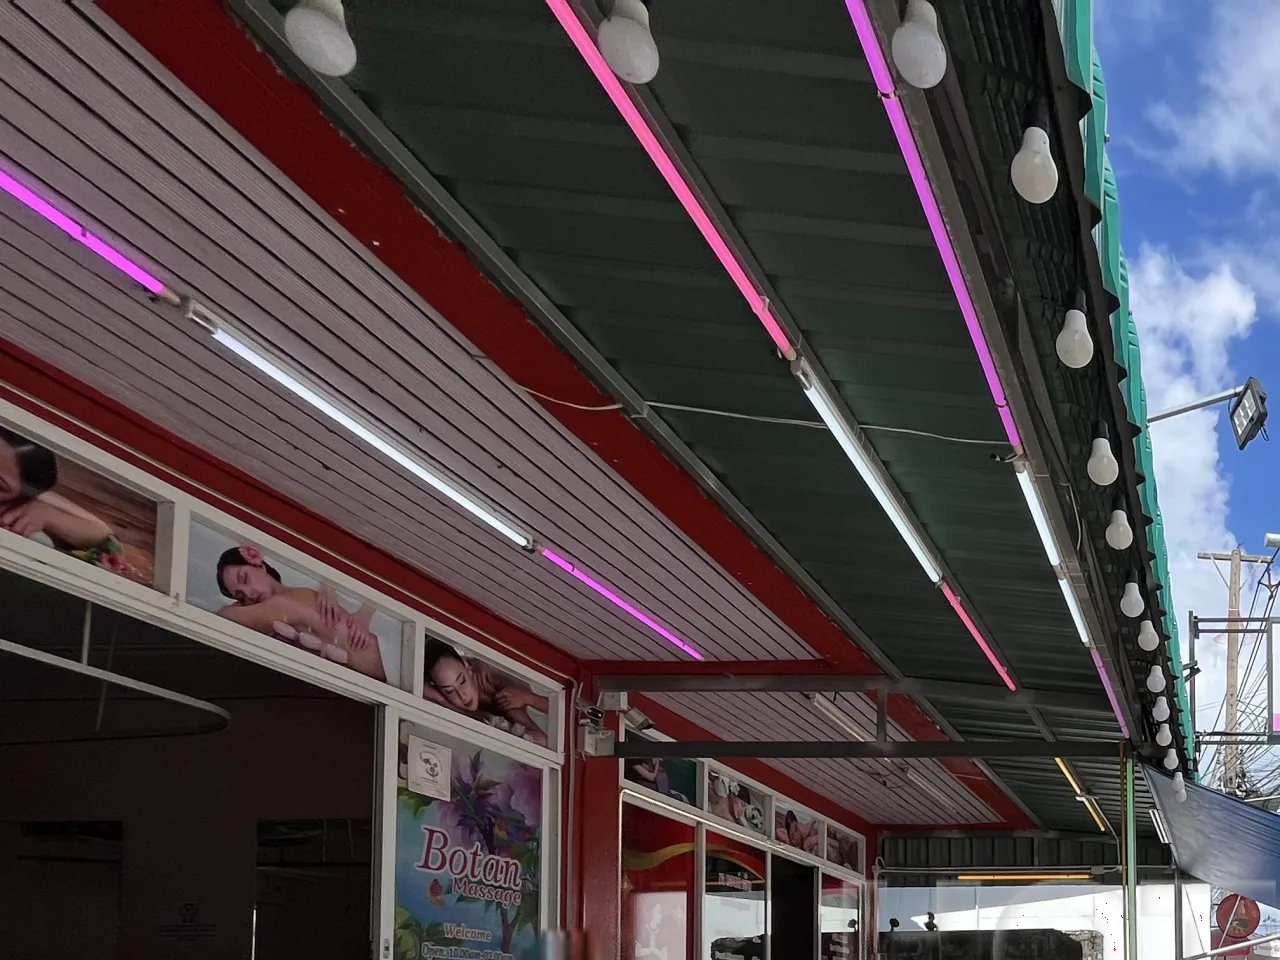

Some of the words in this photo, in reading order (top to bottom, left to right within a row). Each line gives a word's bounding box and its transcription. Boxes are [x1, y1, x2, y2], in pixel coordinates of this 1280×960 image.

[416, 826, 521, 888] Botan
[452, 877, 521, 908] Massage
[444, 923, 492, 942] Welcome
